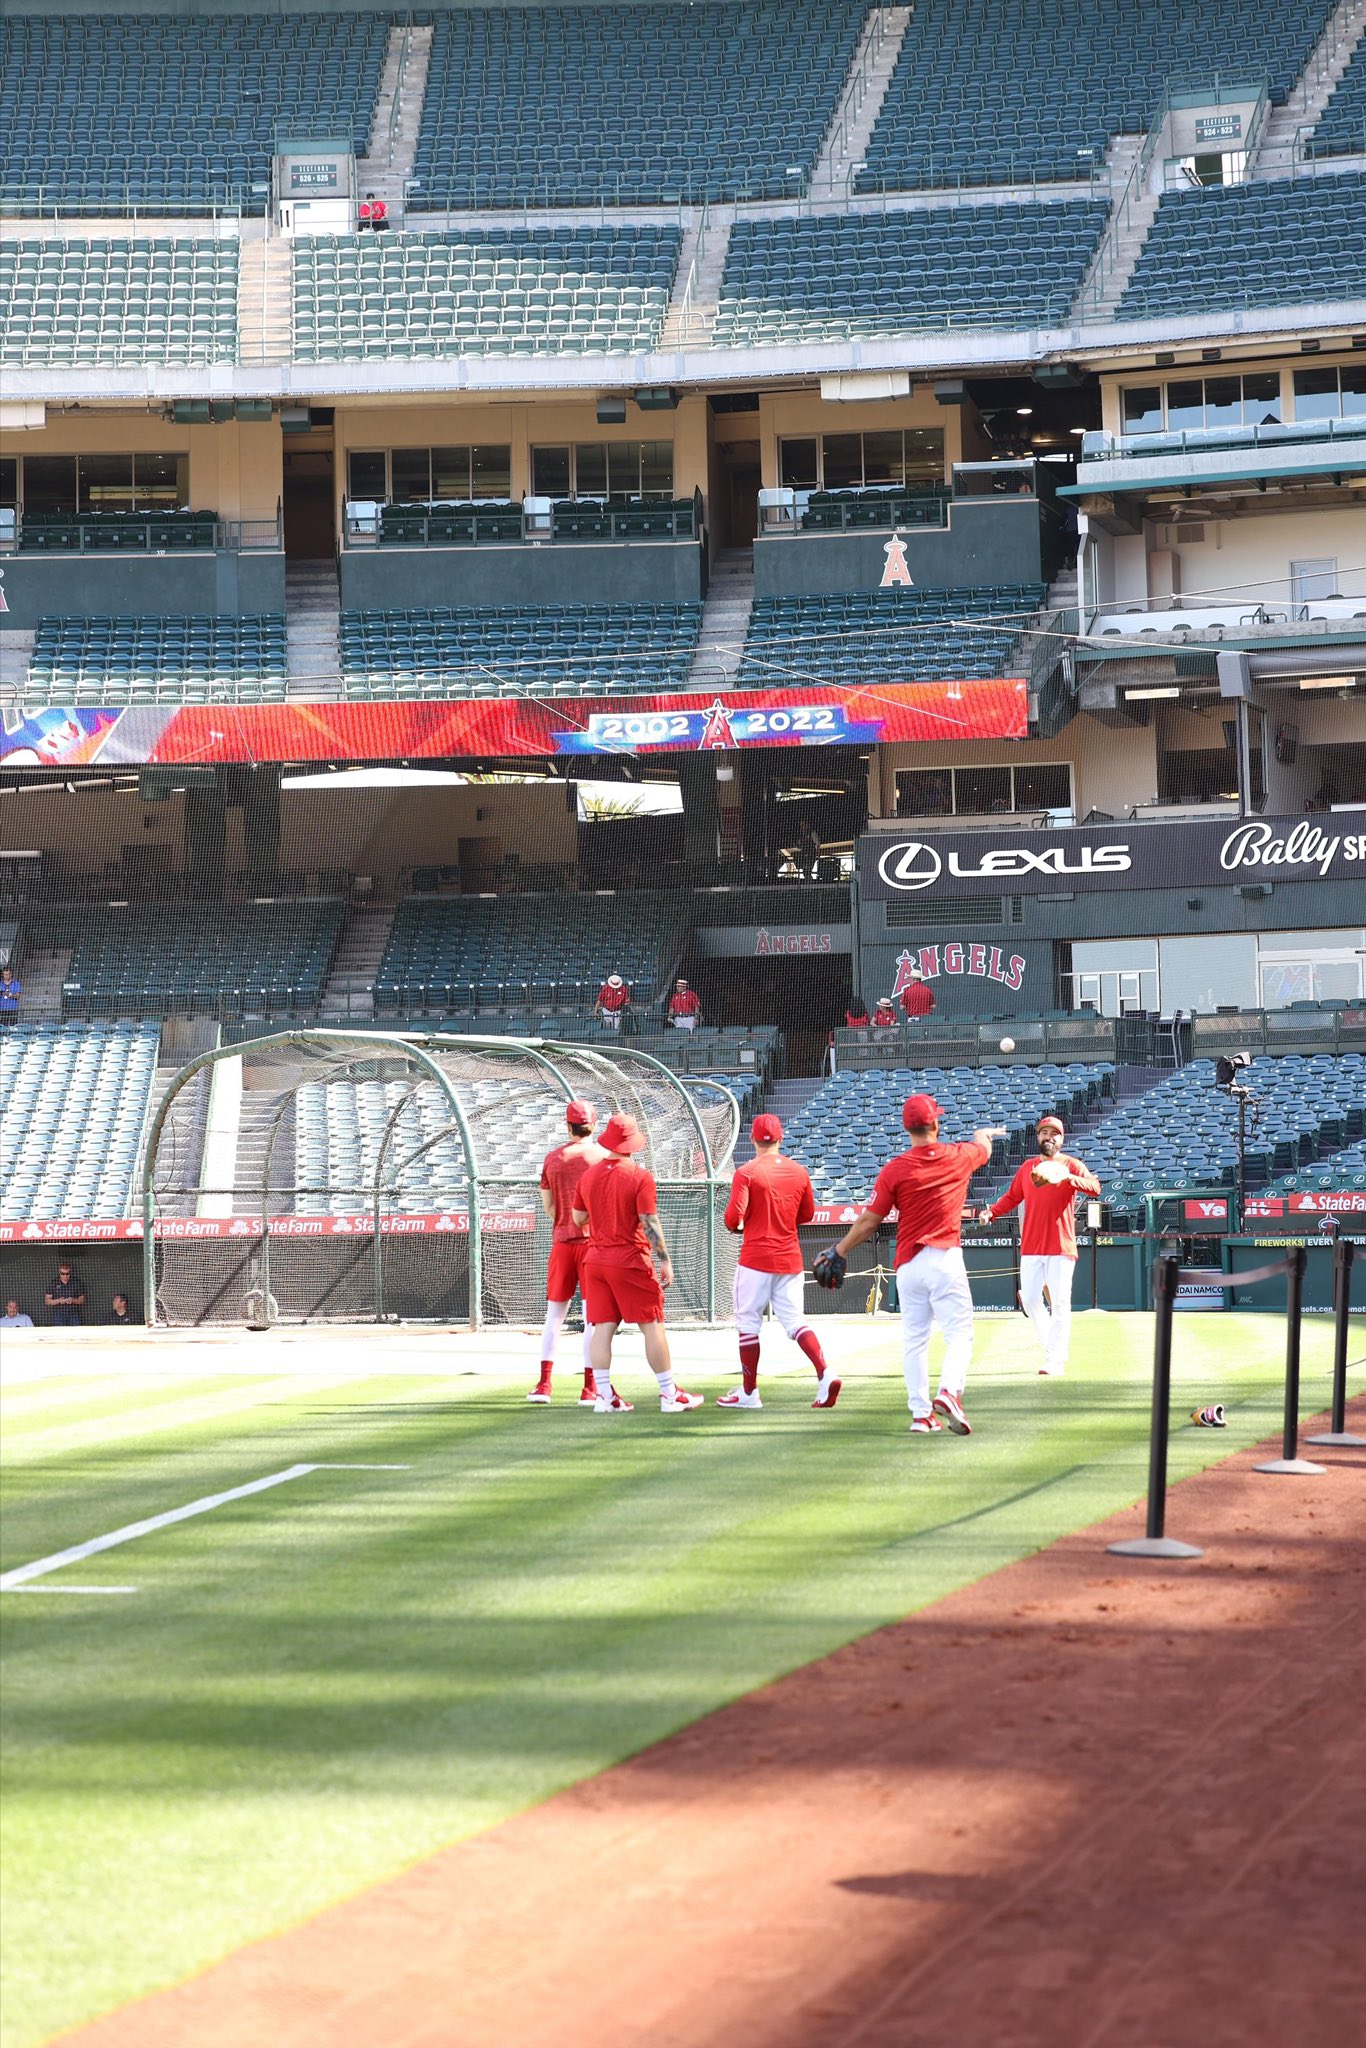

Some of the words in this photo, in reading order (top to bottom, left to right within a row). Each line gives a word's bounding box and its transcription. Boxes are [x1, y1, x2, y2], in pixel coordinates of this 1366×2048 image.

[1203, 116, 1233, 126] SECTIONS
[1203, 128, 1216, 137] 524
[1220, 126, 1233, 135] 523
[602, 717, 690, 739] 2002
[747, 710, 836, 733] 2022
[1220, 821, 1341, 876] Bally
[948, 845, 1132, 878] LEXUS
[754, 927, 832, 955] ANGELS
[891, 943, 1025, 999] ANGELS
[994, 1238, 1012, 1247] HOT
[1254, 1239, 1305, 1248] FIREWORKS!
[1194, 1286, 1224, 1294] NAMCO
